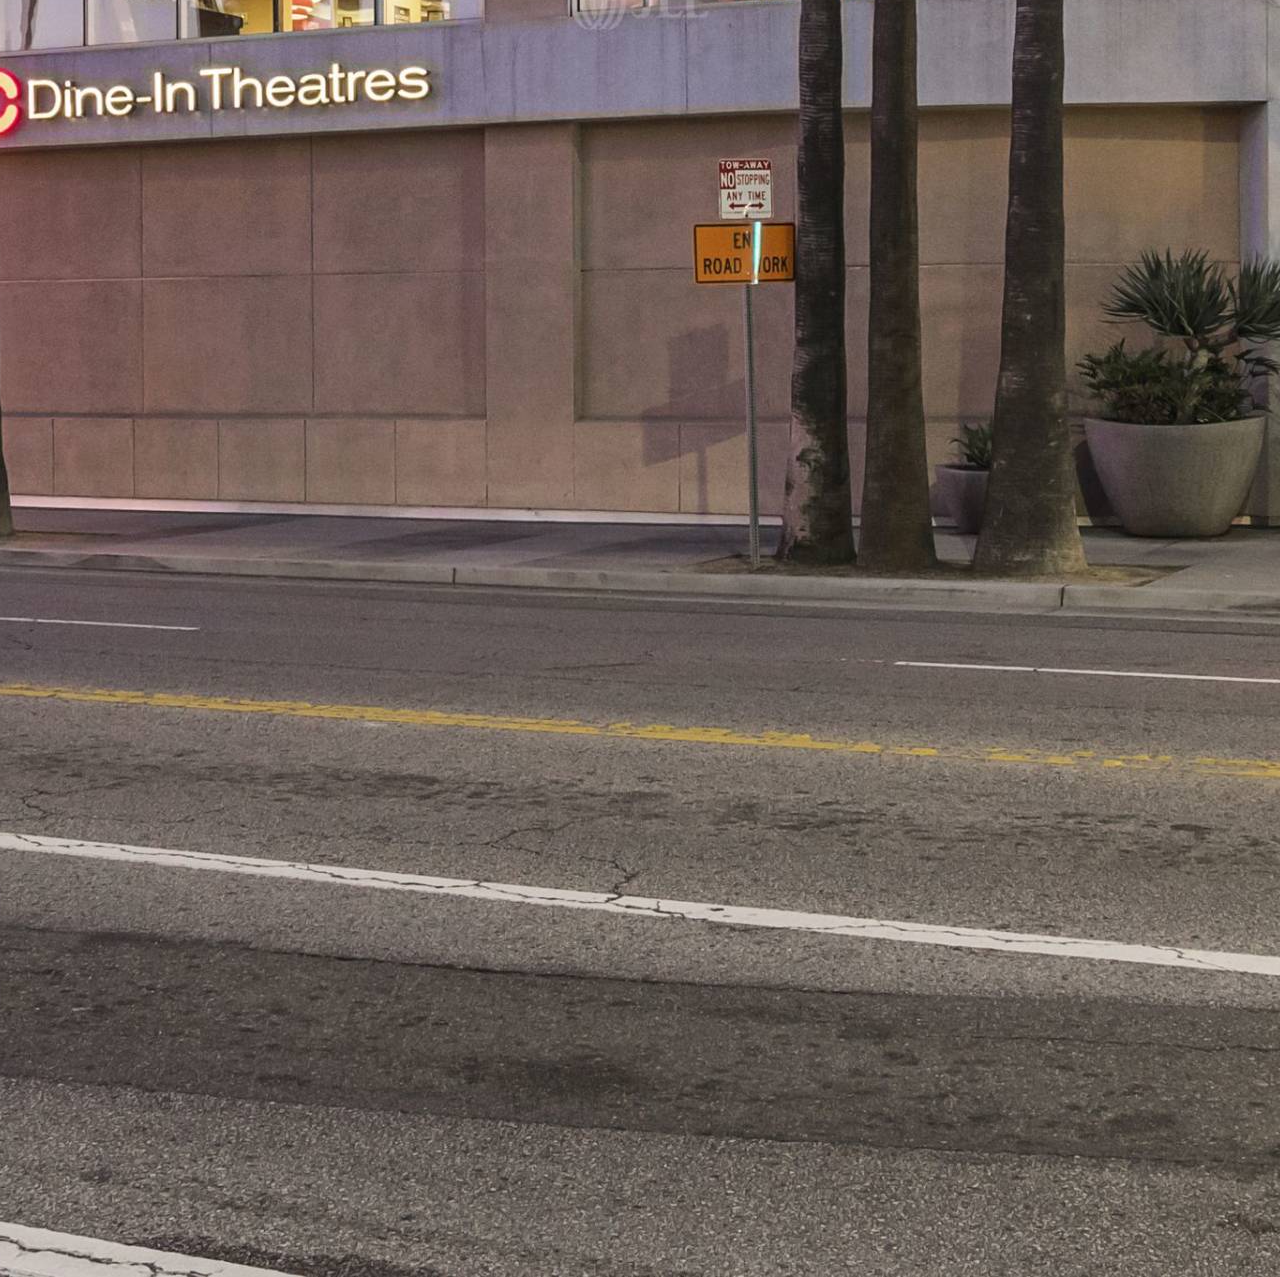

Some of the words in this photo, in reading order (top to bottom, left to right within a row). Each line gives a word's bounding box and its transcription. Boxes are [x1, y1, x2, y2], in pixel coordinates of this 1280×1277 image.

[27, 71, 197, 120] Dine-In
[199, 62, 430, 110] Theatres
[720, 161, 769, 170] TOW-AWAY
[720, 172, 735, 188] NO
[736, 173, 770, 186] STOPPING
[726, 191, 742, 201] ANY
[748, 190, 766, 201] TIME
[733, 232, 751, 249] EN
[703, 257, 742, 275] ROAD
[757, 256, 788, 273] ORK
